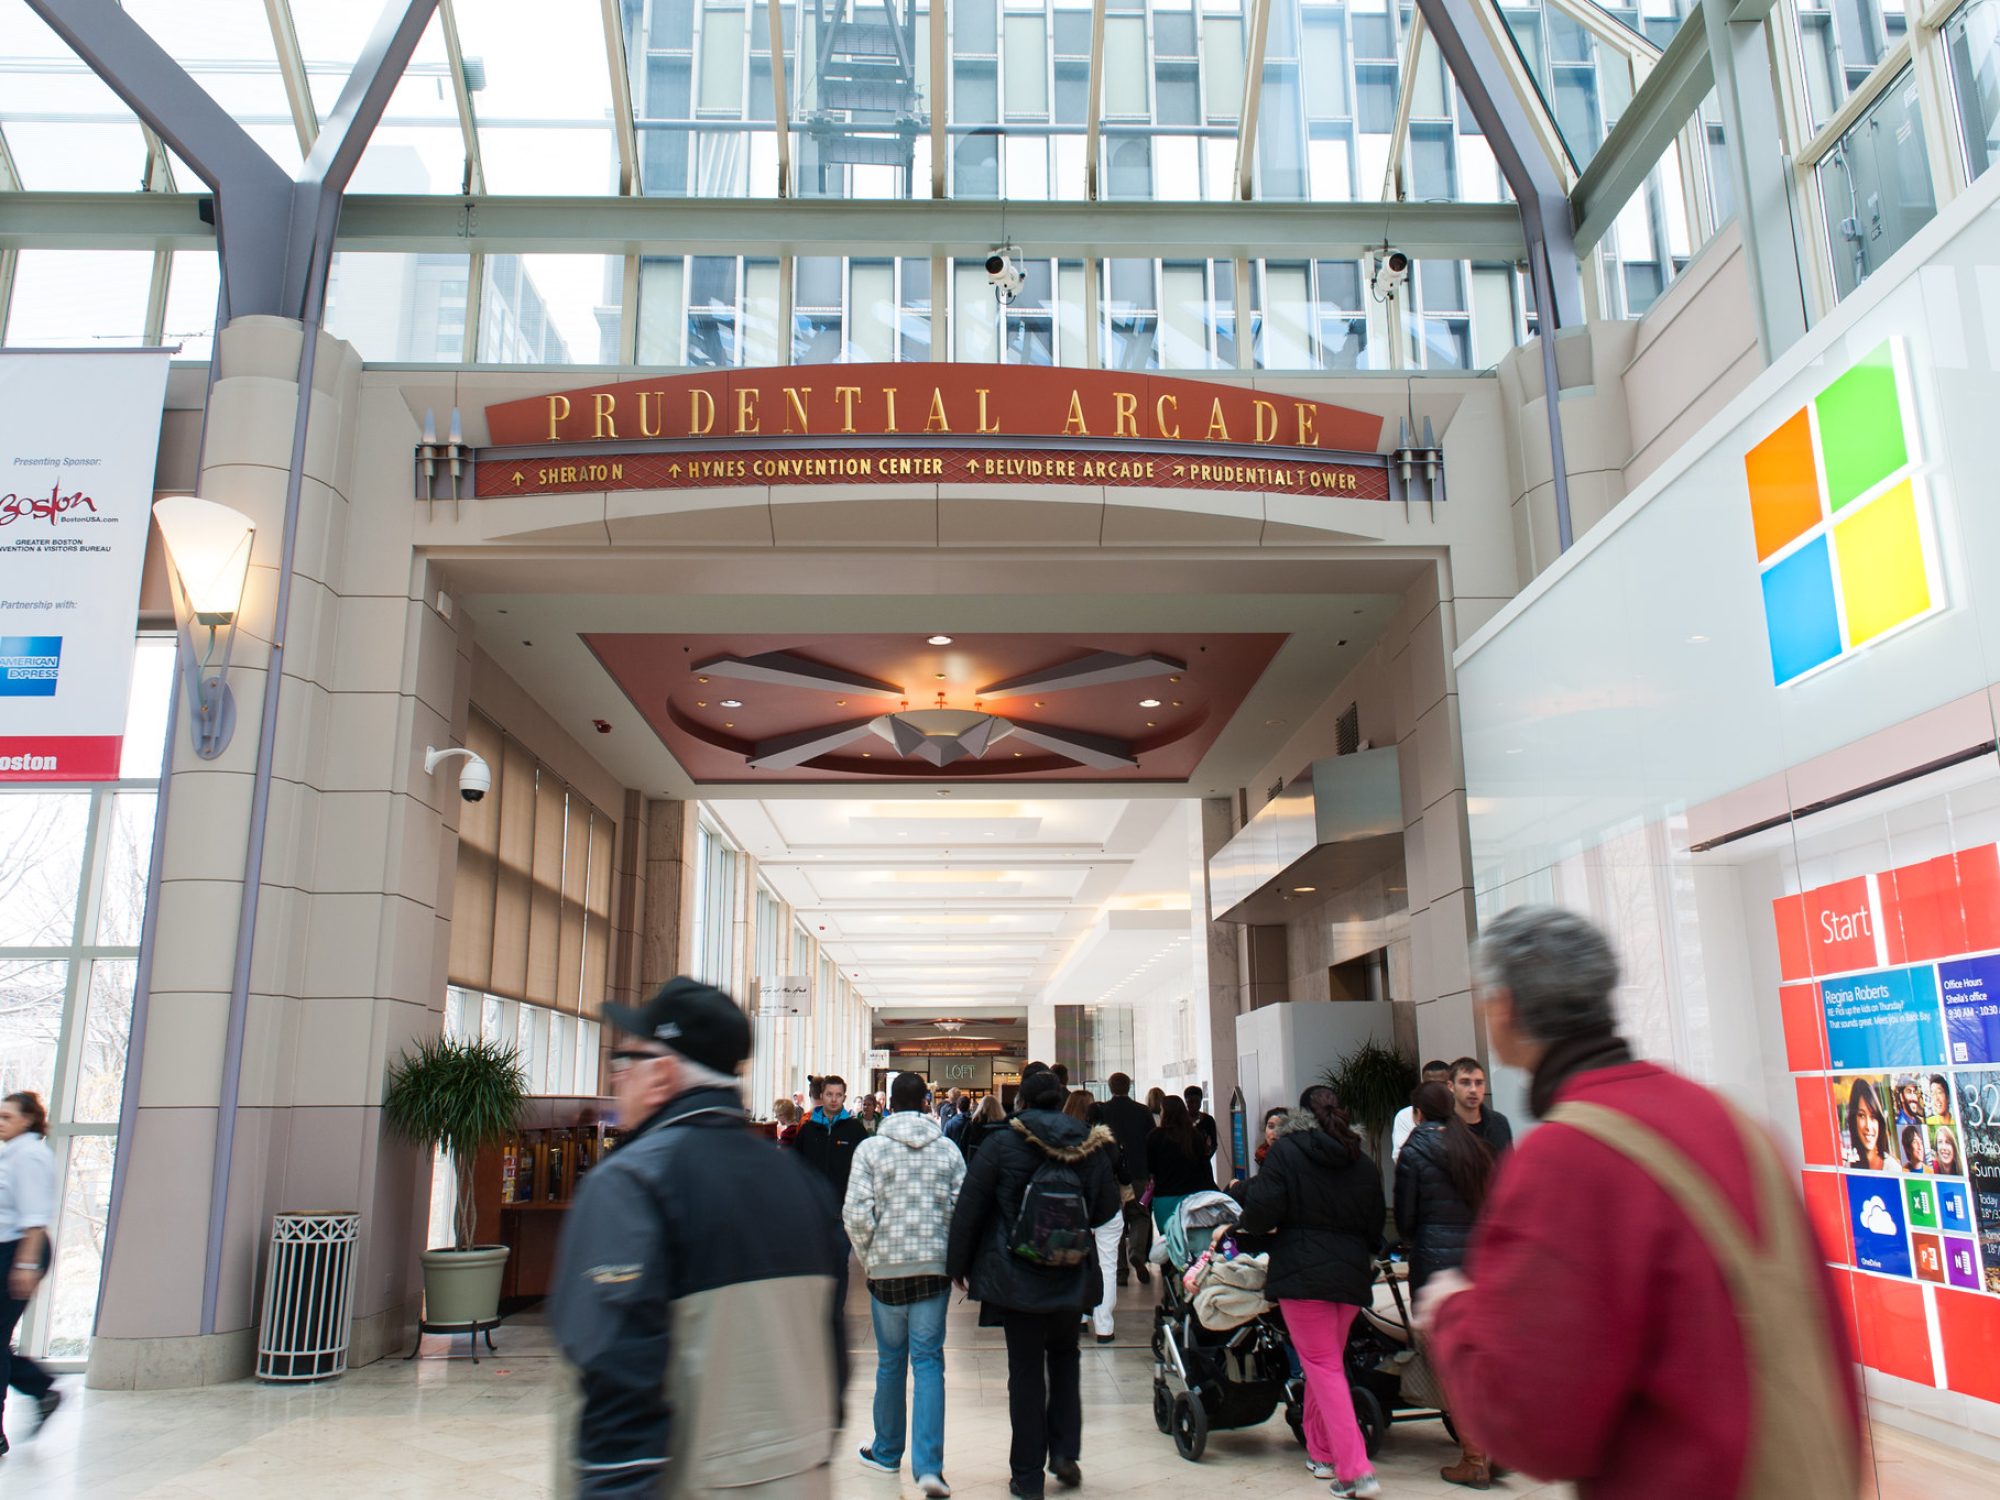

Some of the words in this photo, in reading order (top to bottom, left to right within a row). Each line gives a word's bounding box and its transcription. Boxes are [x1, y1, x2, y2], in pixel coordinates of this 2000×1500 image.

[546, 386, 1000, 440] PRUDENTIAL
[1062, 389, 1320, 448] ARCADE
[13, 457, 60, 467] Presenting
[63, 457, 101, 467] Sponsor:
[688, 461, 745, 478] HYNES
[753, 458, 871, 477] CONVENTION
[879, 457, 943, 475] CENTER
[985, 459, 1076, 478] BELVIDERE
[1083, 461, 1154, 479] ARCADE
[539, 464, 623, 485] SHERATON
[1190, 464, 1293, 487] PRUDENTIAL
[1298, 469, 1357, 490] TOWER
[0, 600, 52, 611] Partnership
[55, 600, 77, 610] with:
[0, 656, 57, 667] AMERICAN
[9, 669, 58, 679] EXPRESS
[1820, 904, 1871, 944] Start
[1944, 979, 1963, 990] Office
[1963, 978, 1983, 988] Hours
[1825, 989, 1853, 1007] Regina
[1855, 984, 1889, 1001] Roberts
[1945, 993, 1969, 1004] Sheila's
[1969, 991, 1988, 1002] office
[945, 1064, 976, 1080] LOFT
[1964, 1084, 2000, 1127] 32
